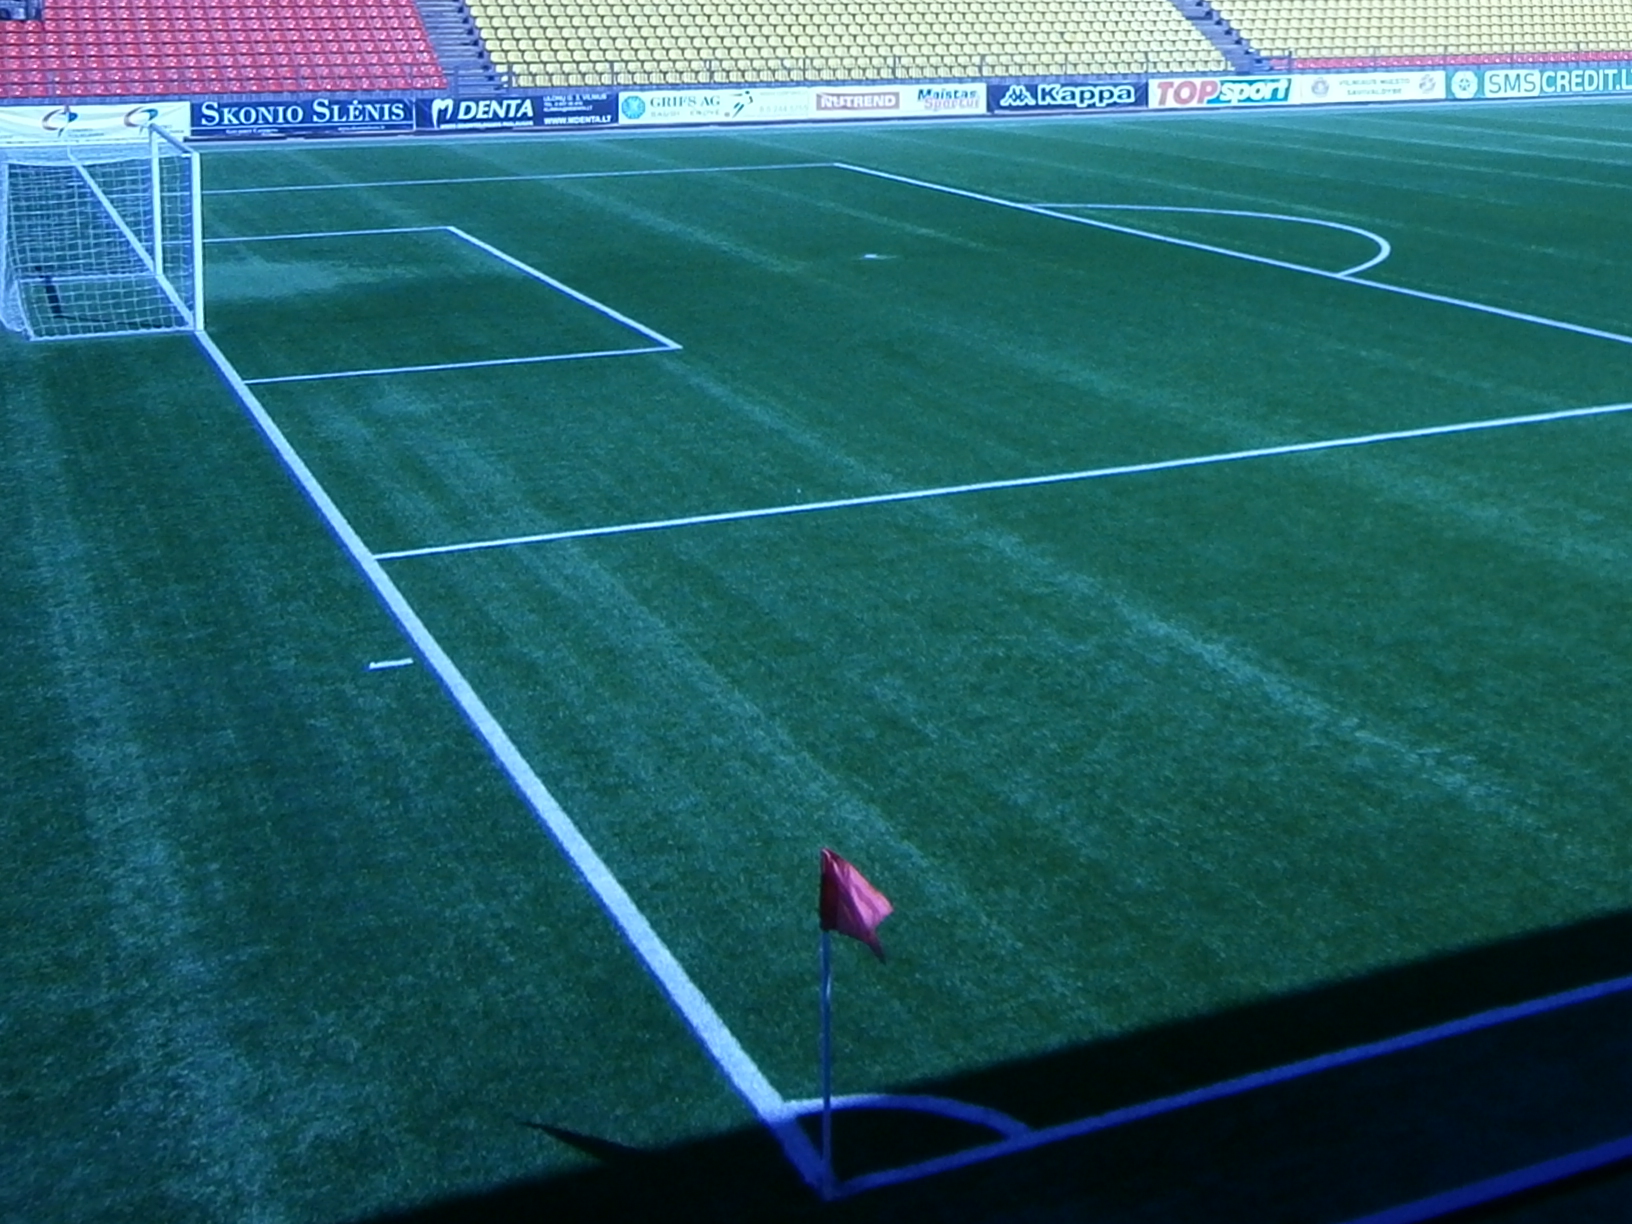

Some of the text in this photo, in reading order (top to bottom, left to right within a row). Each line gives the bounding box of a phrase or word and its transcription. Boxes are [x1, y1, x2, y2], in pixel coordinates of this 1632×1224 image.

[650, 94, 720, 108] GRIFS AG
[821, 94, 896, 108] NUTREND
[1038, 83, 1135, 107] Kappa
[201, 98, 405, 126] SKONIO SLĖNIS
[457, 99, 533, 120] DENTA
